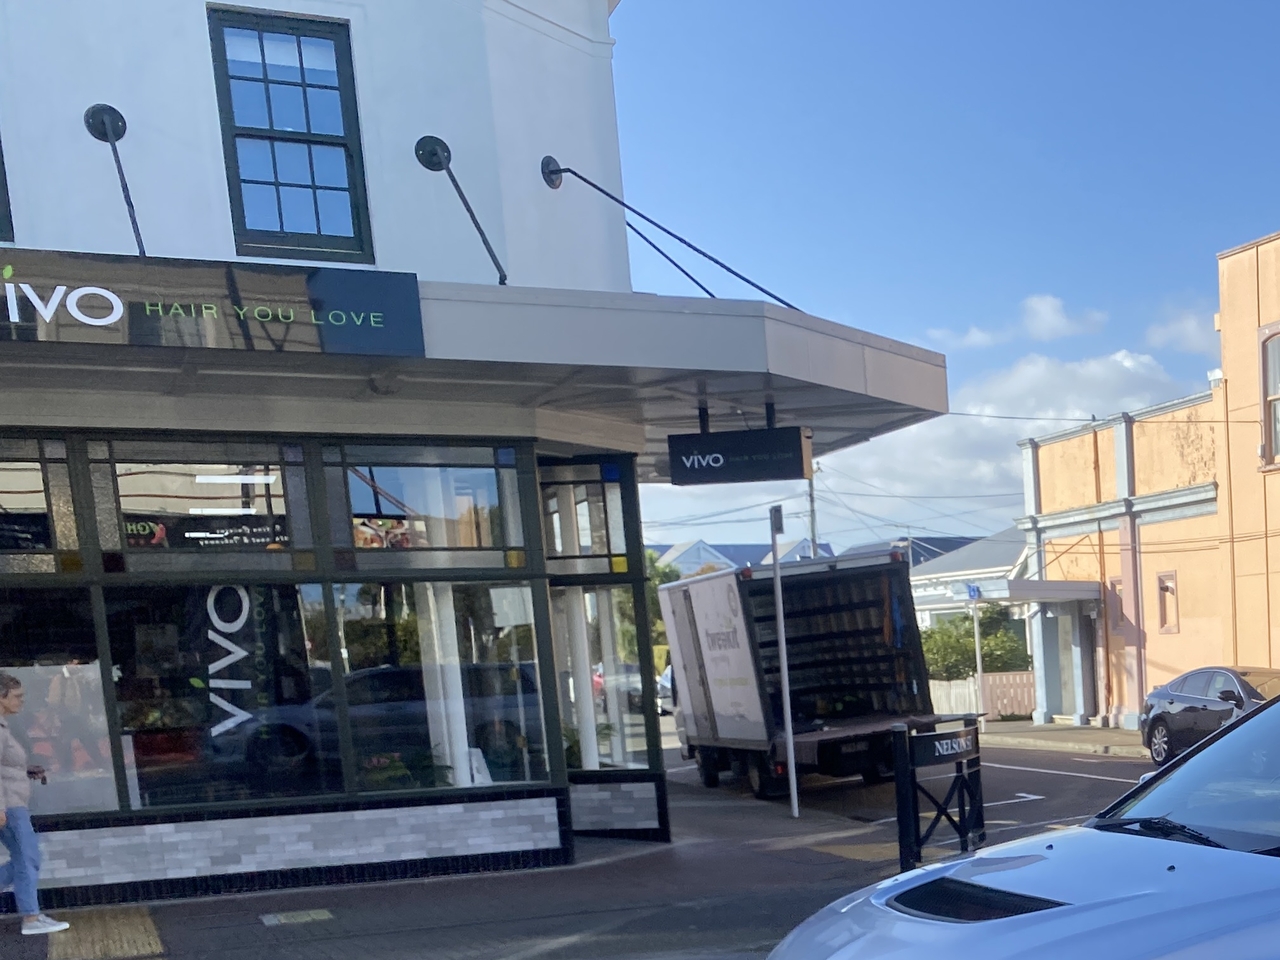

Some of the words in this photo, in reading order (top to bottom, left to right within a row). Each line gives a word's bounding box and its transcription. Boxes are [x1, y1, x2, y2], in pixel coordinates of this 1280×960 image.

[146, 302, 218, 319] HAIR
[235, 305, 294, 323] YOU
[311, 309, 385, 327] LOVE
